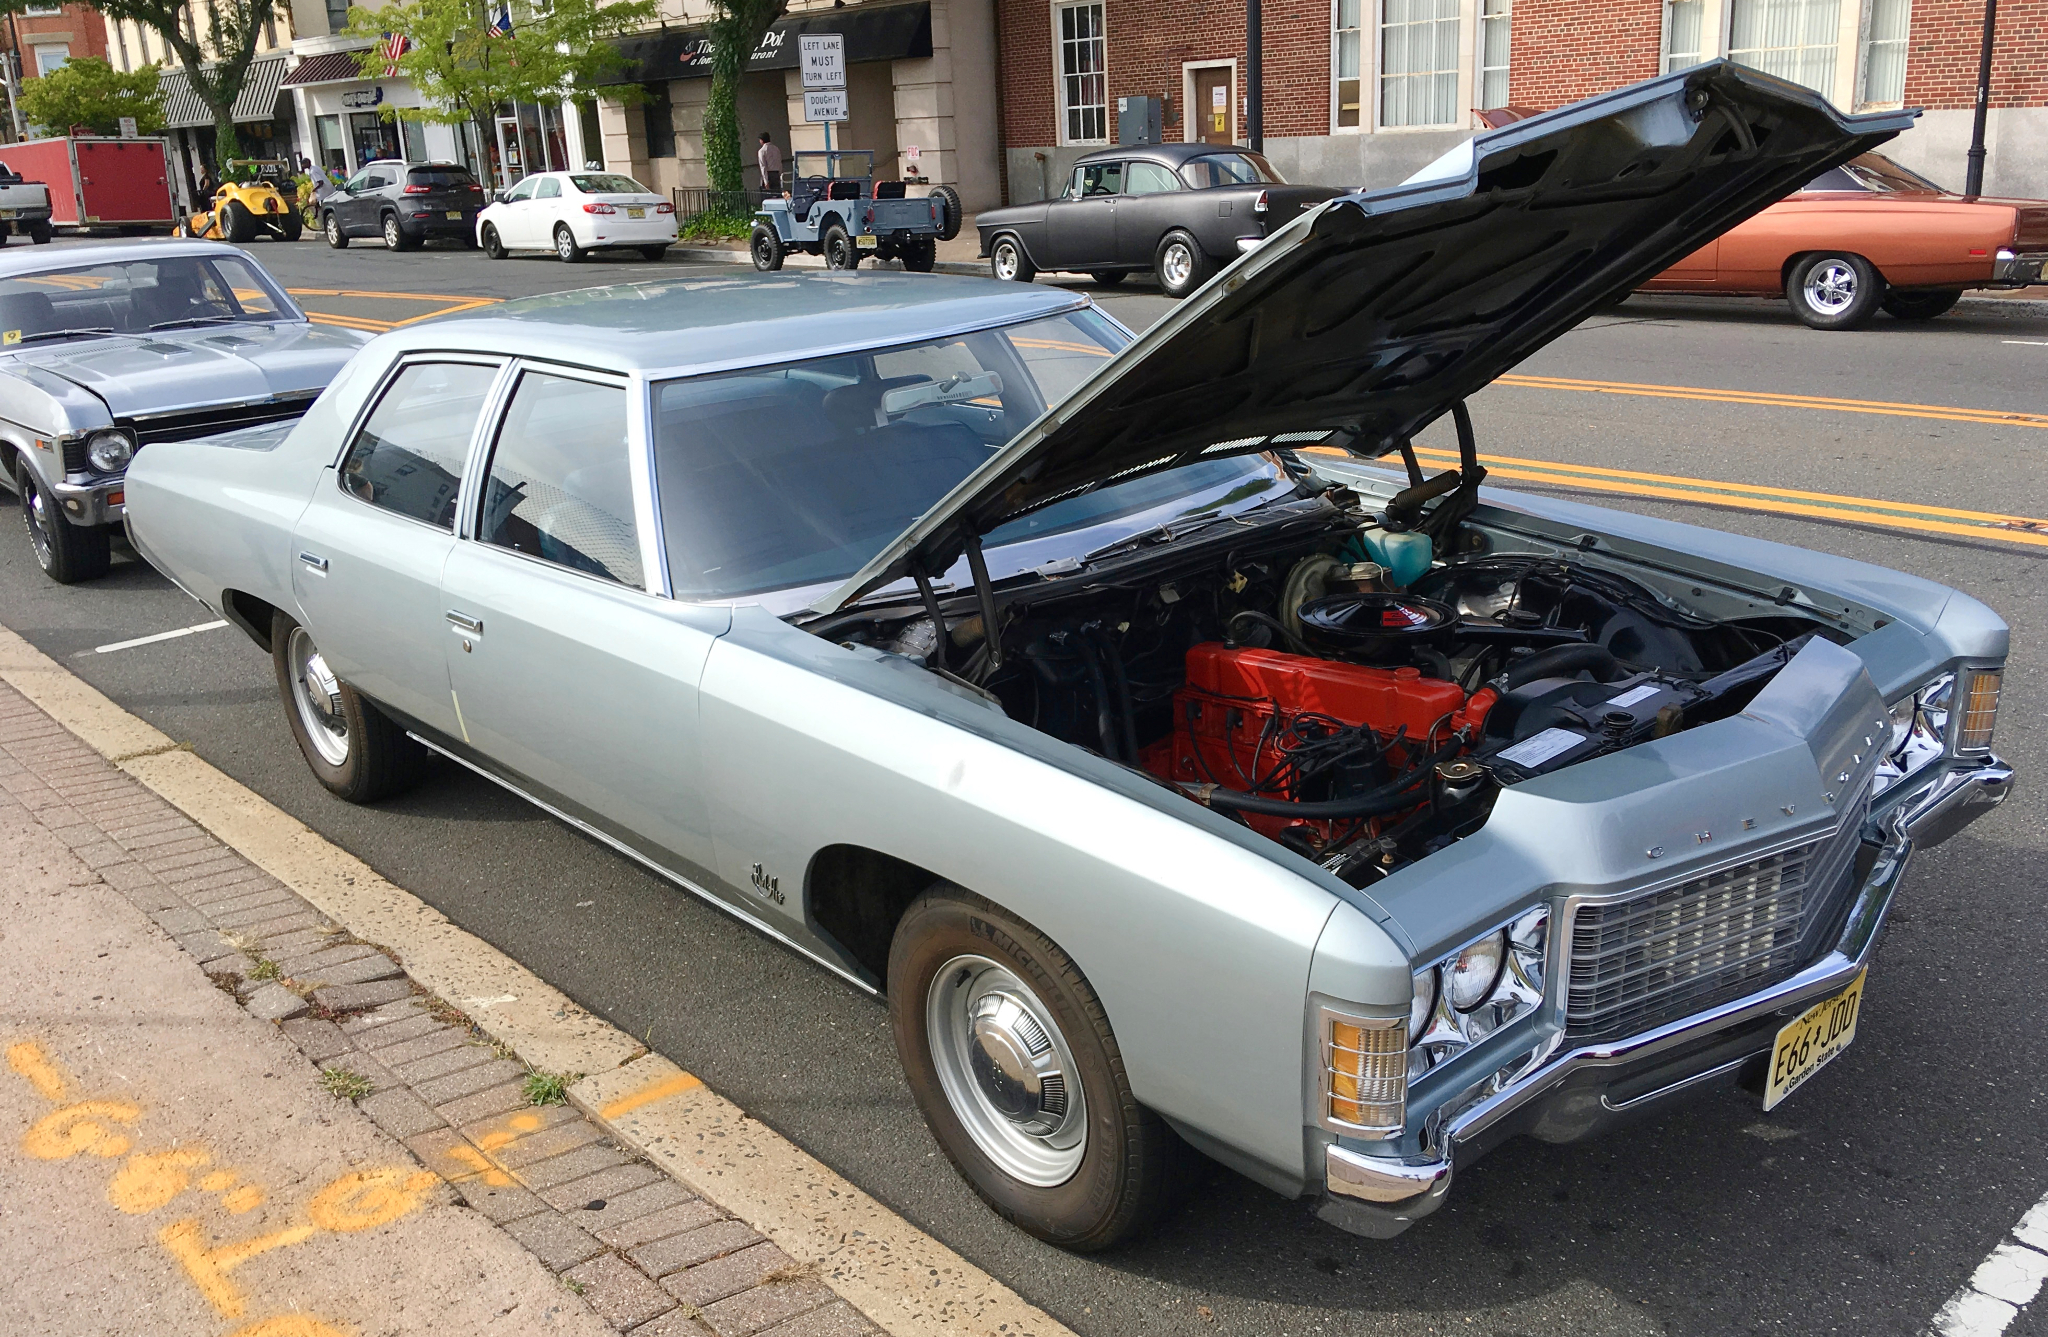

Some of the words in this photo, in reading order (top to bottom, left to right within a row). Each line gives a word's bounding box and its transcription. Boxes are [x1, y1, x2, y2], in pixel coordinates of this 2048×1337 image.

[696, 39, 716, 54] The
[761, 30, 786, 48] Pot
[803, 42, 819, 50] LEFT
[823, 41, 840, 50] LANE
[811, 56, 835, 67] MUST
[805, 72, 823, 81] TURN
[826, 71, 842, 80] LEFT
[810, 95, 841, 105] DOUGHTY
[813, 107, 839, 116] AVENUE
[1789, 1063, 1815, 1088] Garden
[1816, 1046, 1835, 1067] State
